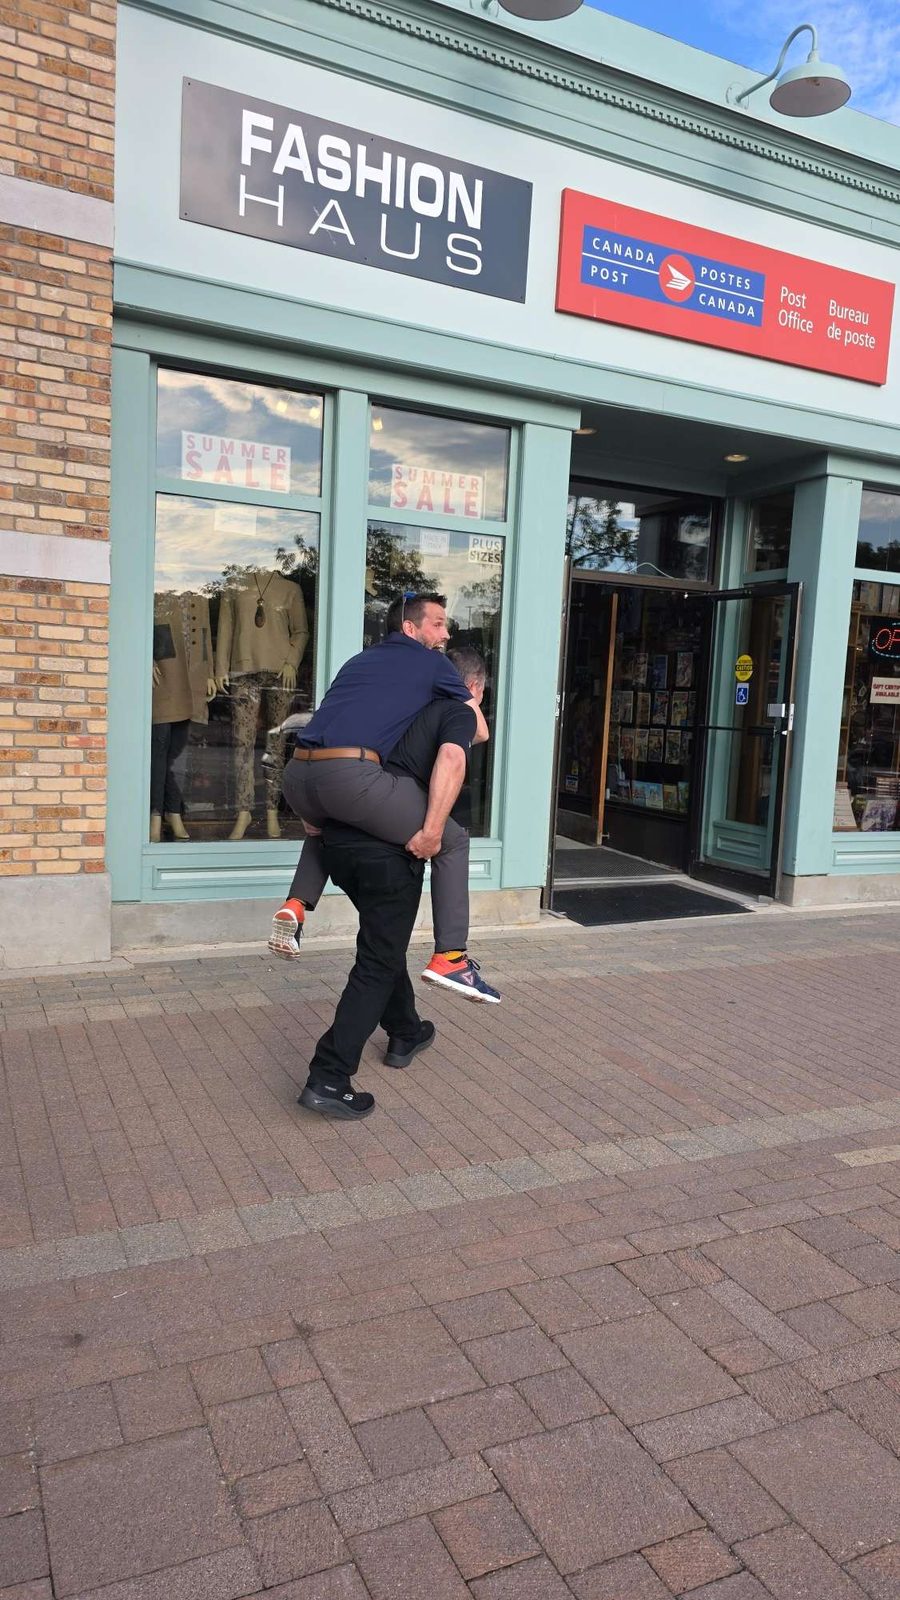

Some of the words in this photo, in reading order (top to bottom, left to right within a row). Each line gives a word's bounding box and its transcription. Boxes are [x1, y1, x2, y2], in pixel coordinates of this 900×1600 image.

[241, 109, 483, 229] FASHION
[239, 174, 482, 276] HAUS
[592, 238, 655, 264] CANADA
[590, 265, 629, 286] POST
[700, 266, 751, 290] POSTES
[699, 293, 755, 318] CANADA
[780, 286, 807, 309] Post
[778, 309, 813, 334] Office
[828, 299, 869, 326] Bureau
[827, 323, 841, 341] de
[844, 330, 876, 350] poste
[187, 434, 287, 463] SUMMER
[186, 450, 287, 491] SALE
[395, 465, 479, 491] SUMMER
[393, 482, 479, 517] SALE
[469, 550, 500, 564] SIZES
[472, 537, 501, 552] PLUS
